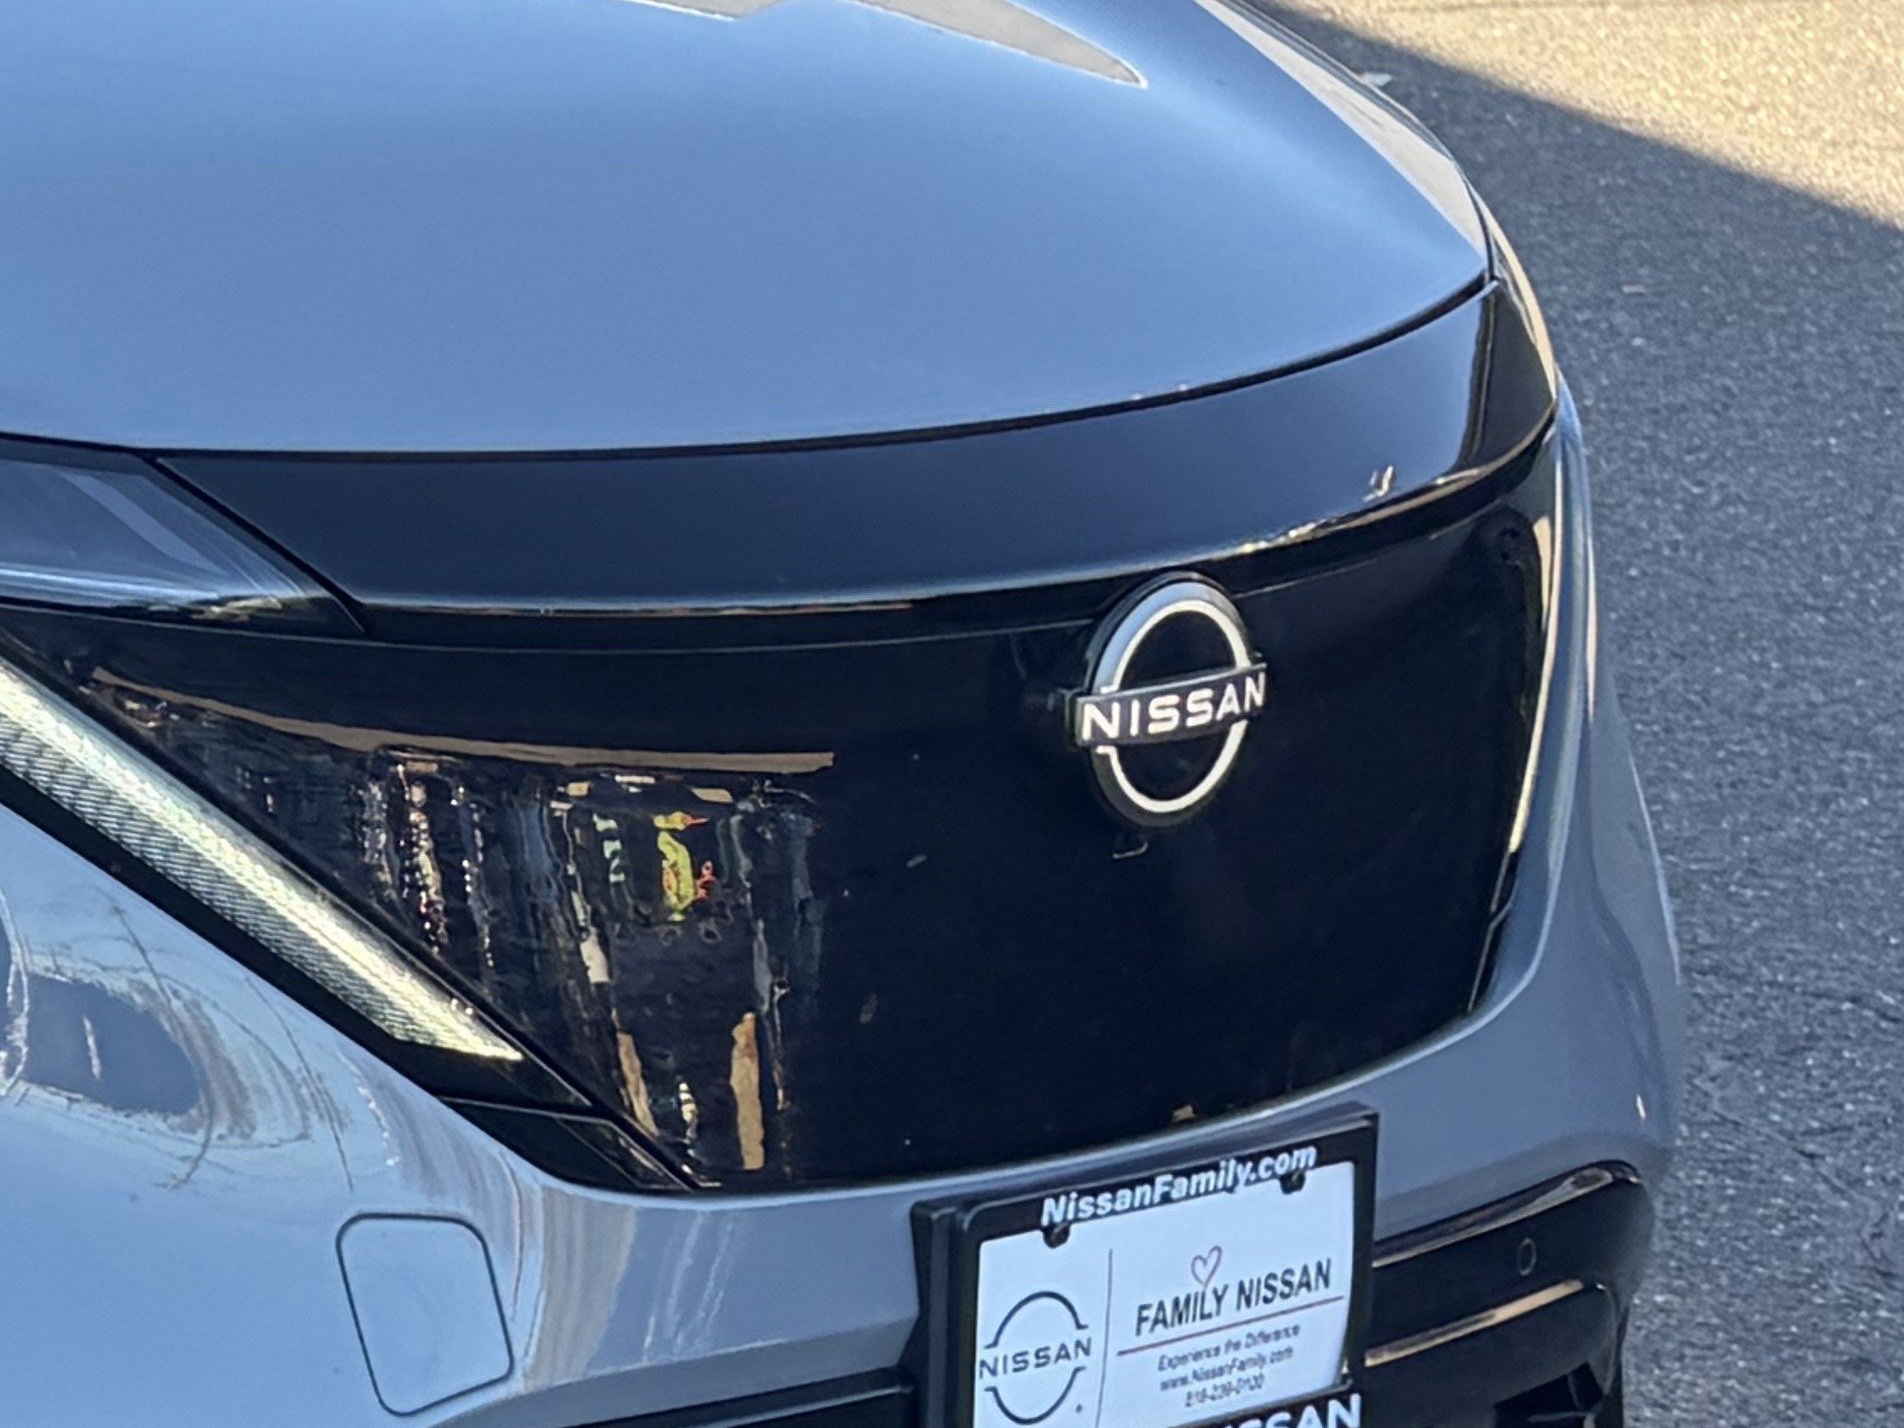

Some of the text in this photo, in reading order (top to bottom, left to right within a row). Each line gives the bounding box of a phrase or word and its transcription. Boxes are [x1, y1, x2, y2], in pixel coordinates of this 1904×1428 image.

[1081, 671, 1266, 742] NISSAN
[1040, 1144, 1317, 1227] NissanFamily.com
[1134, 1257, 1332, 1338] FAMILY NISSAN
[979, 1336, 1092, 1380] NISSAN
[1157, 1345, 1221, 1371] Experience
